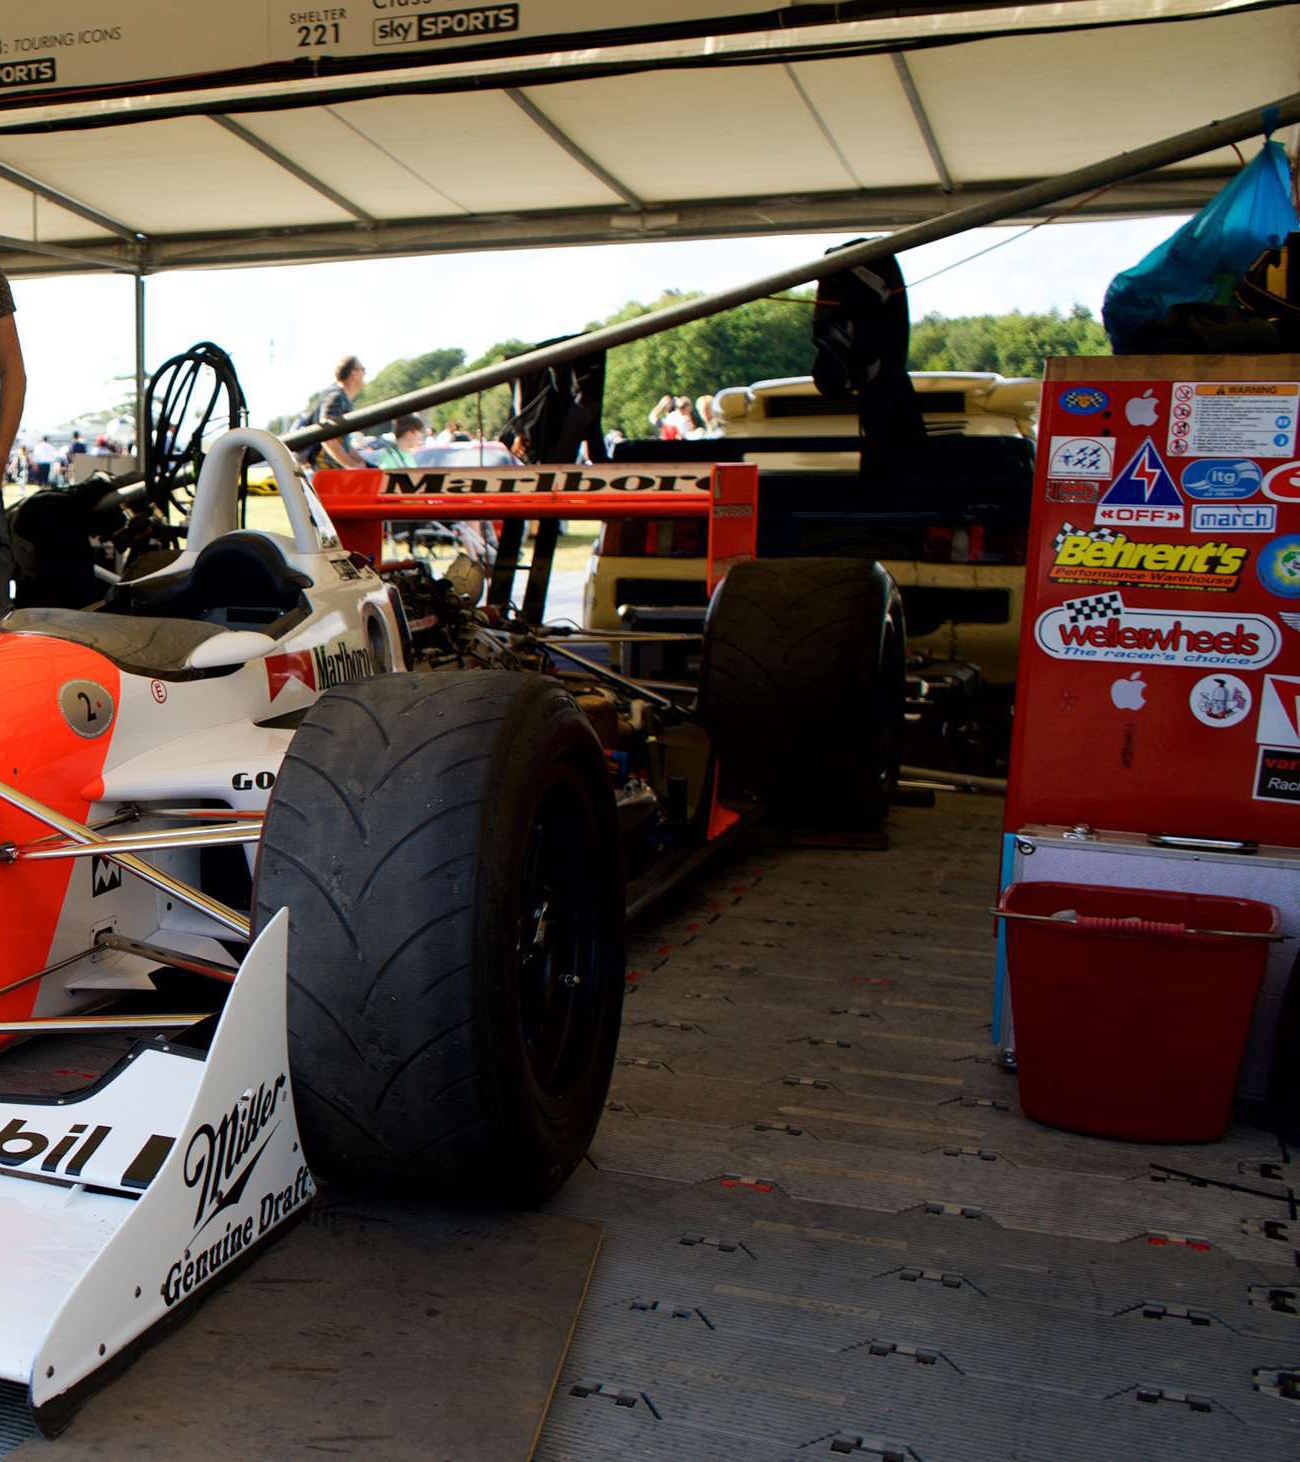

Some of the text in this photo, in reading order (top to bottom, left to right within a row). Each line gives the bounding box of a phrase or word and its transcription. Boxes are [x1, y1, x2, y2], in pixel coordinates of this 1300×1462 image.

[289, 8, 347, 25] SHELTER
[378, 9, 515, 41] sky SPORTS
[13, 30, 74, 53] TOURING
[77, 26, 122, 45] ICONS
[297, 23, 341, 47] 221
[1228, 385, 1278, 394] WARNING
[1211, 468, 1236, 484] itg
[1115, 508, 1165, 522] OFF
[1200, 510, 1268, 527] march
[1054, 534, 1247, 575] Behrent's
[1055, 567, 1233, 586] Performance Warehouse
[1058, 616, 1261, 656] wellerwheels
[312, 640, 372, 691] Marlboro
[1062, 645, 1252, 666] The racer's choice
[76, 692, 98, 722] 2
[232, 771, 276, 791] GO
[183, 1072, 286, 1229] Miller
[163, 1165, 311, 1307] Genuine Draft
